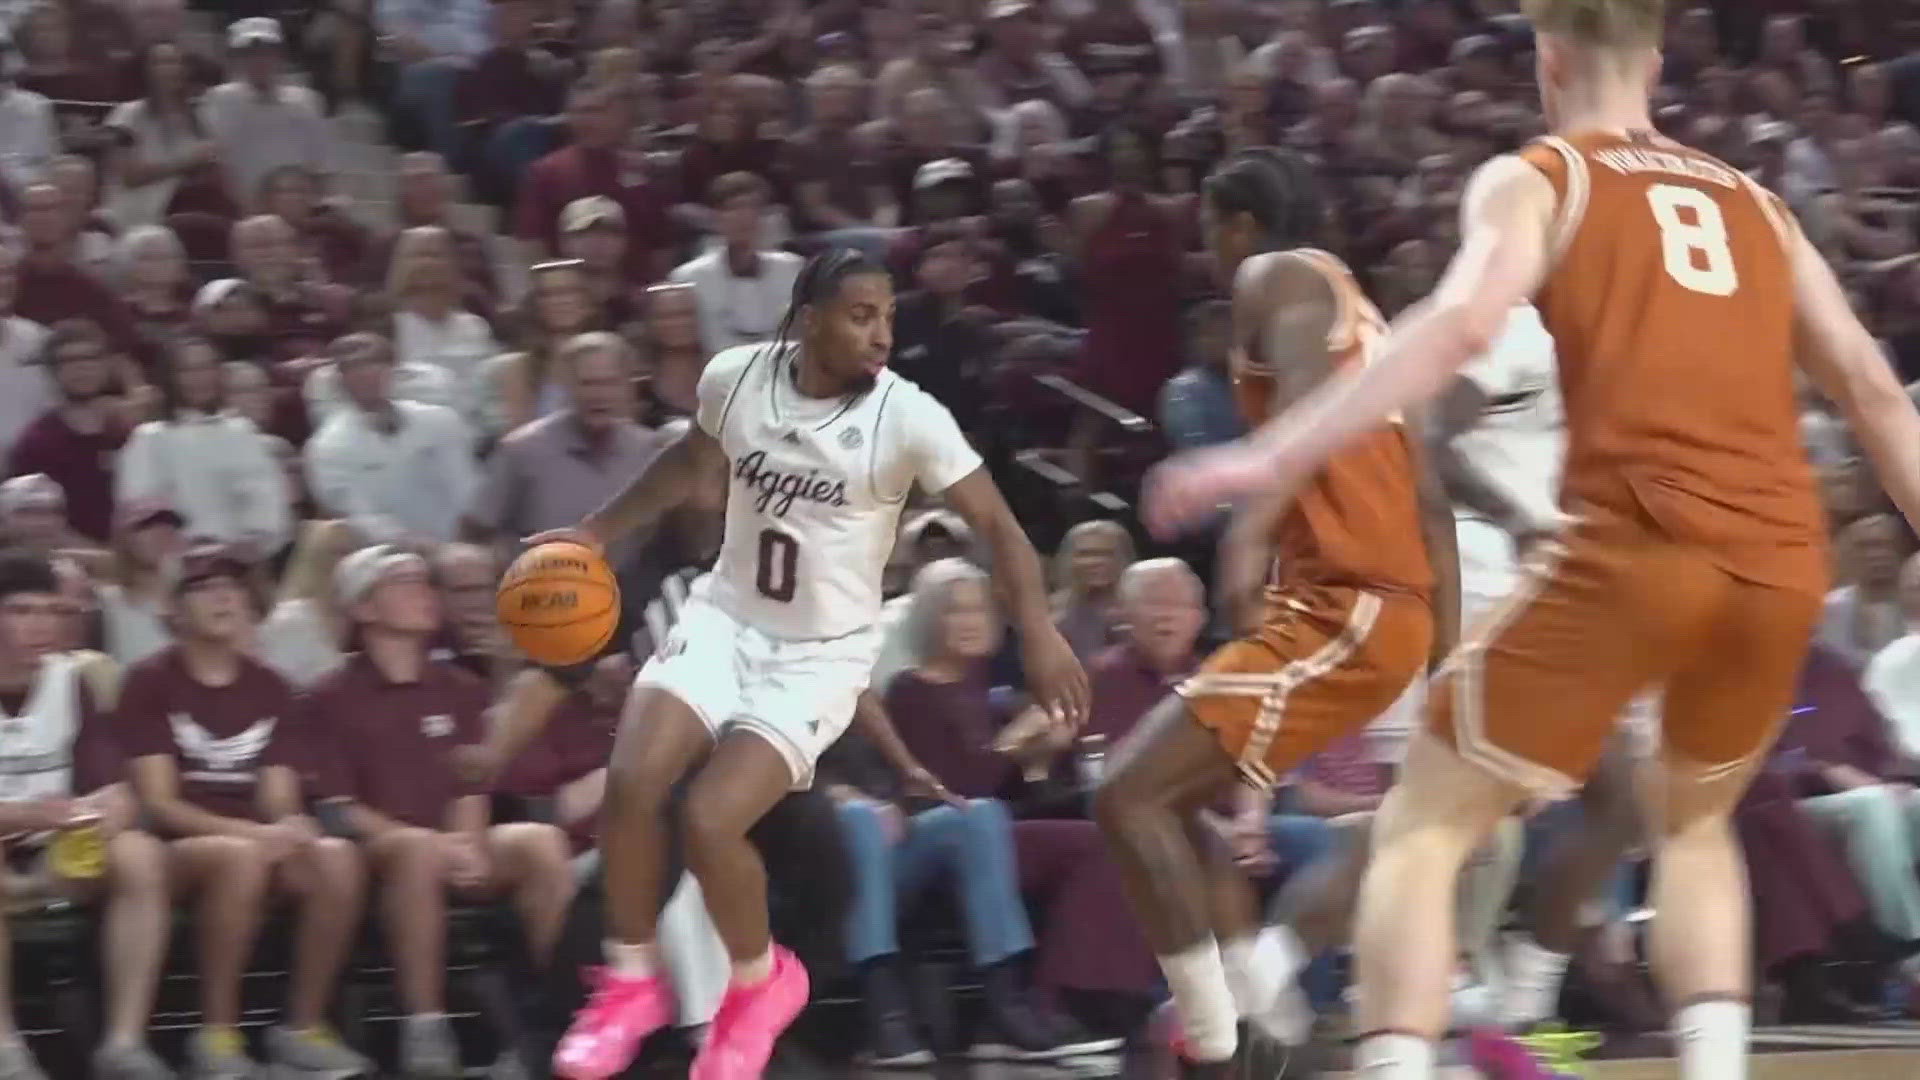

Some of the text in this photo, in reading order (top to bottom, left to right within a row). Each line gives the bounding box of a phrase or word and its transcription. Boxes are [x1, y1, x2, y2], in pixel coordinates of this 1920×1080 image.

[1646, 183, 1738, 297] 8
[736, 450, 850, 518] Aggies
[757, 528, 799, 602] 0
